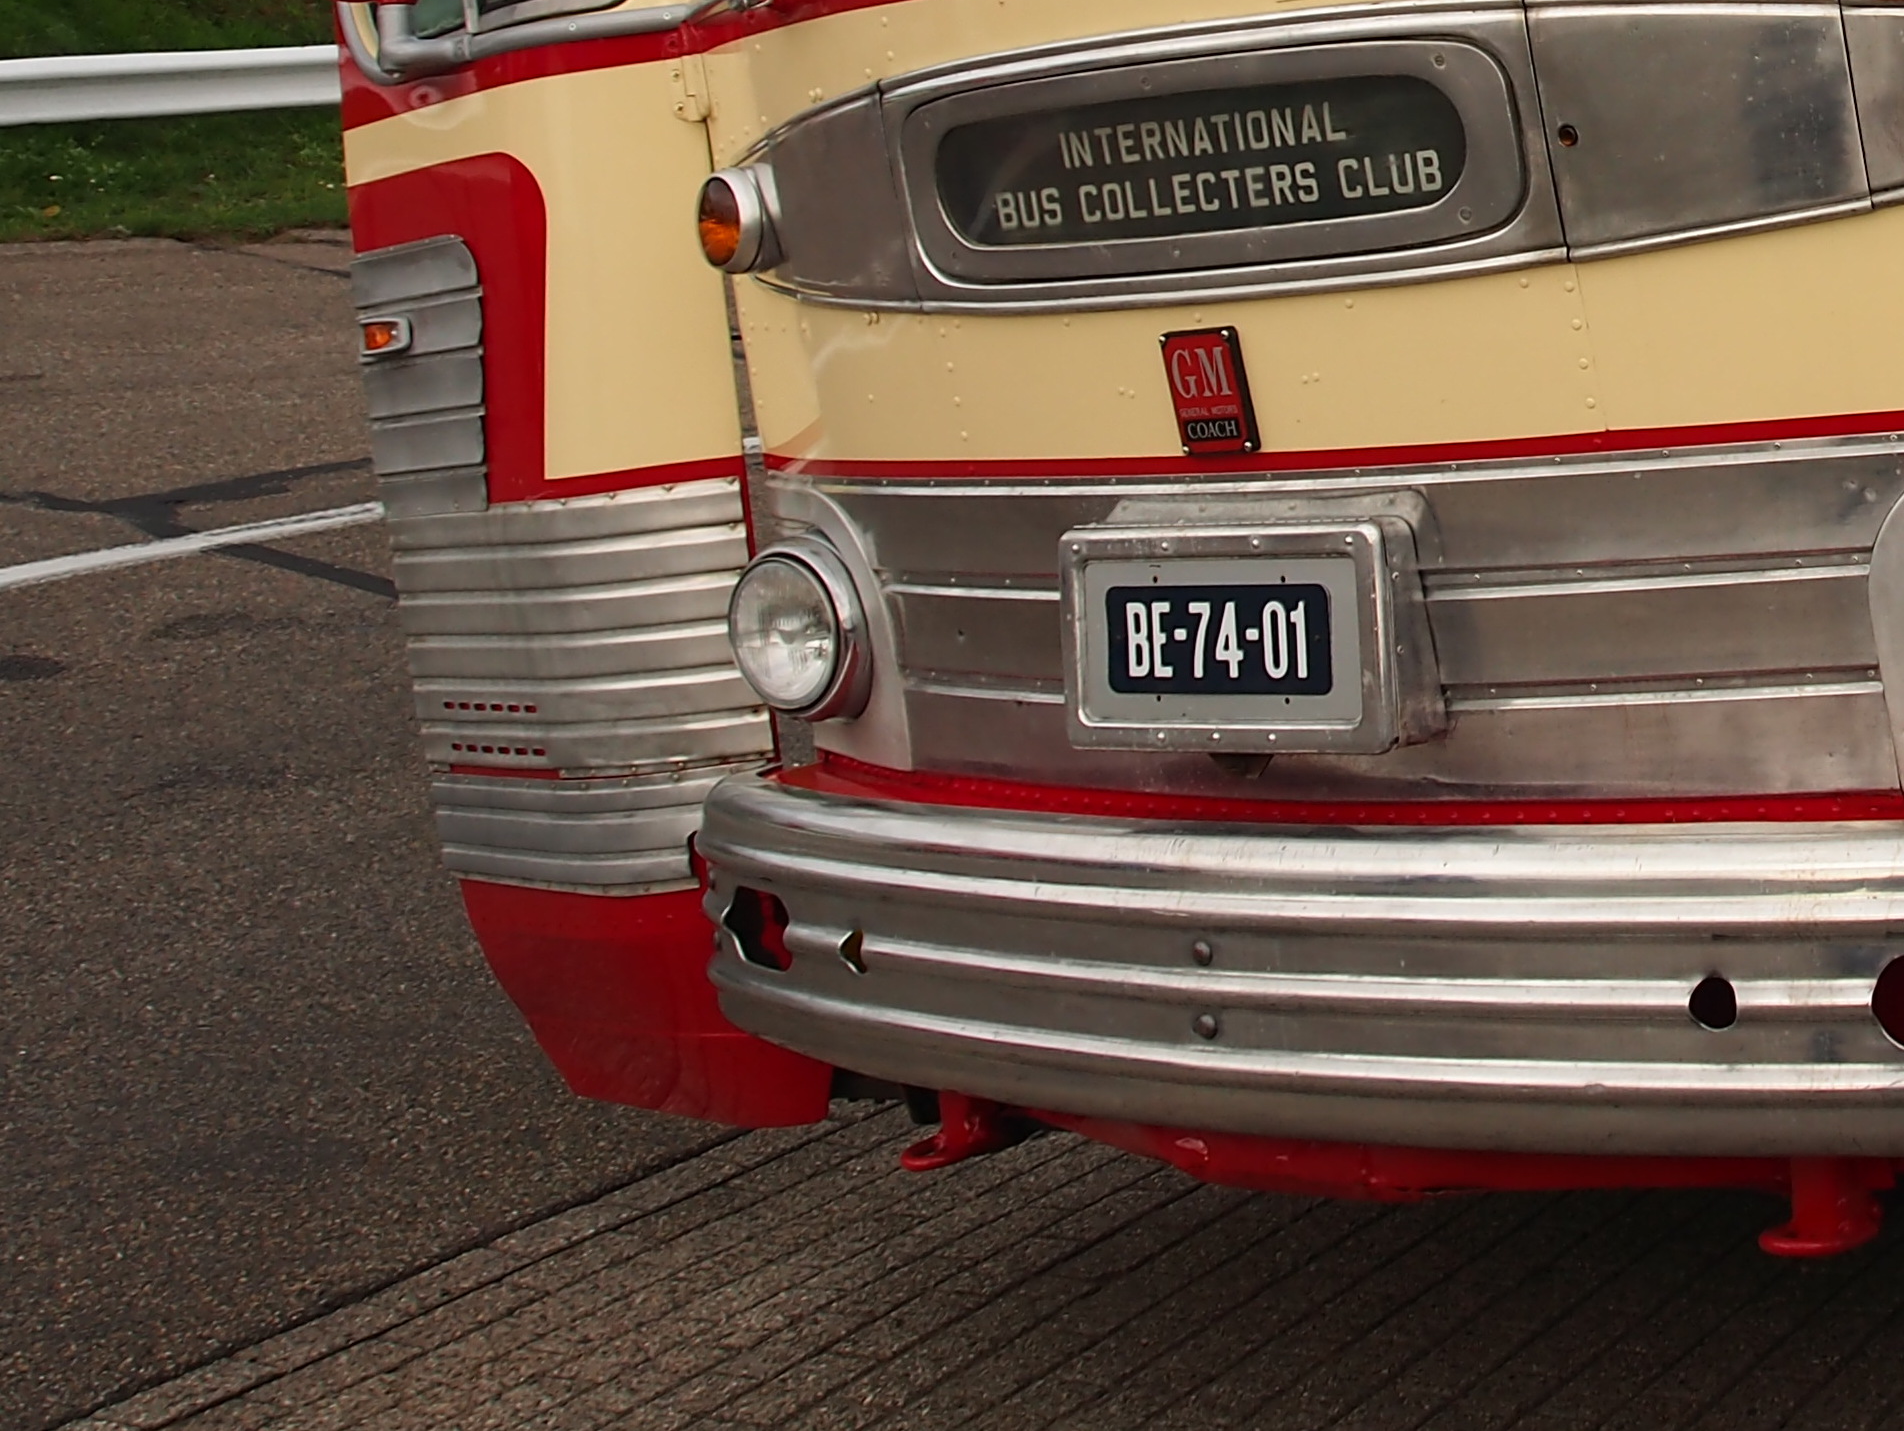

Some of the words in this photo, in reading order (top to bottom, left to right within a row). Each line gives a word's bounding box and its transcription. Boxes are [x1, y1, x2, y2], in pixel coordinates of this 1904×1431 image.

[1058, 101, 1347, 169] INTERNATIONAL
[995, 188, 1063, 231] BUS
[1079, 161, 1320, 226] COLLECTERS
[1337, 148, 1443, 199] CLUB
[1171, 346, 1232, 398] GM
[1187, 420, 1238, 439] COACH
[1124, 600, 1309, 680] BE-74-01
